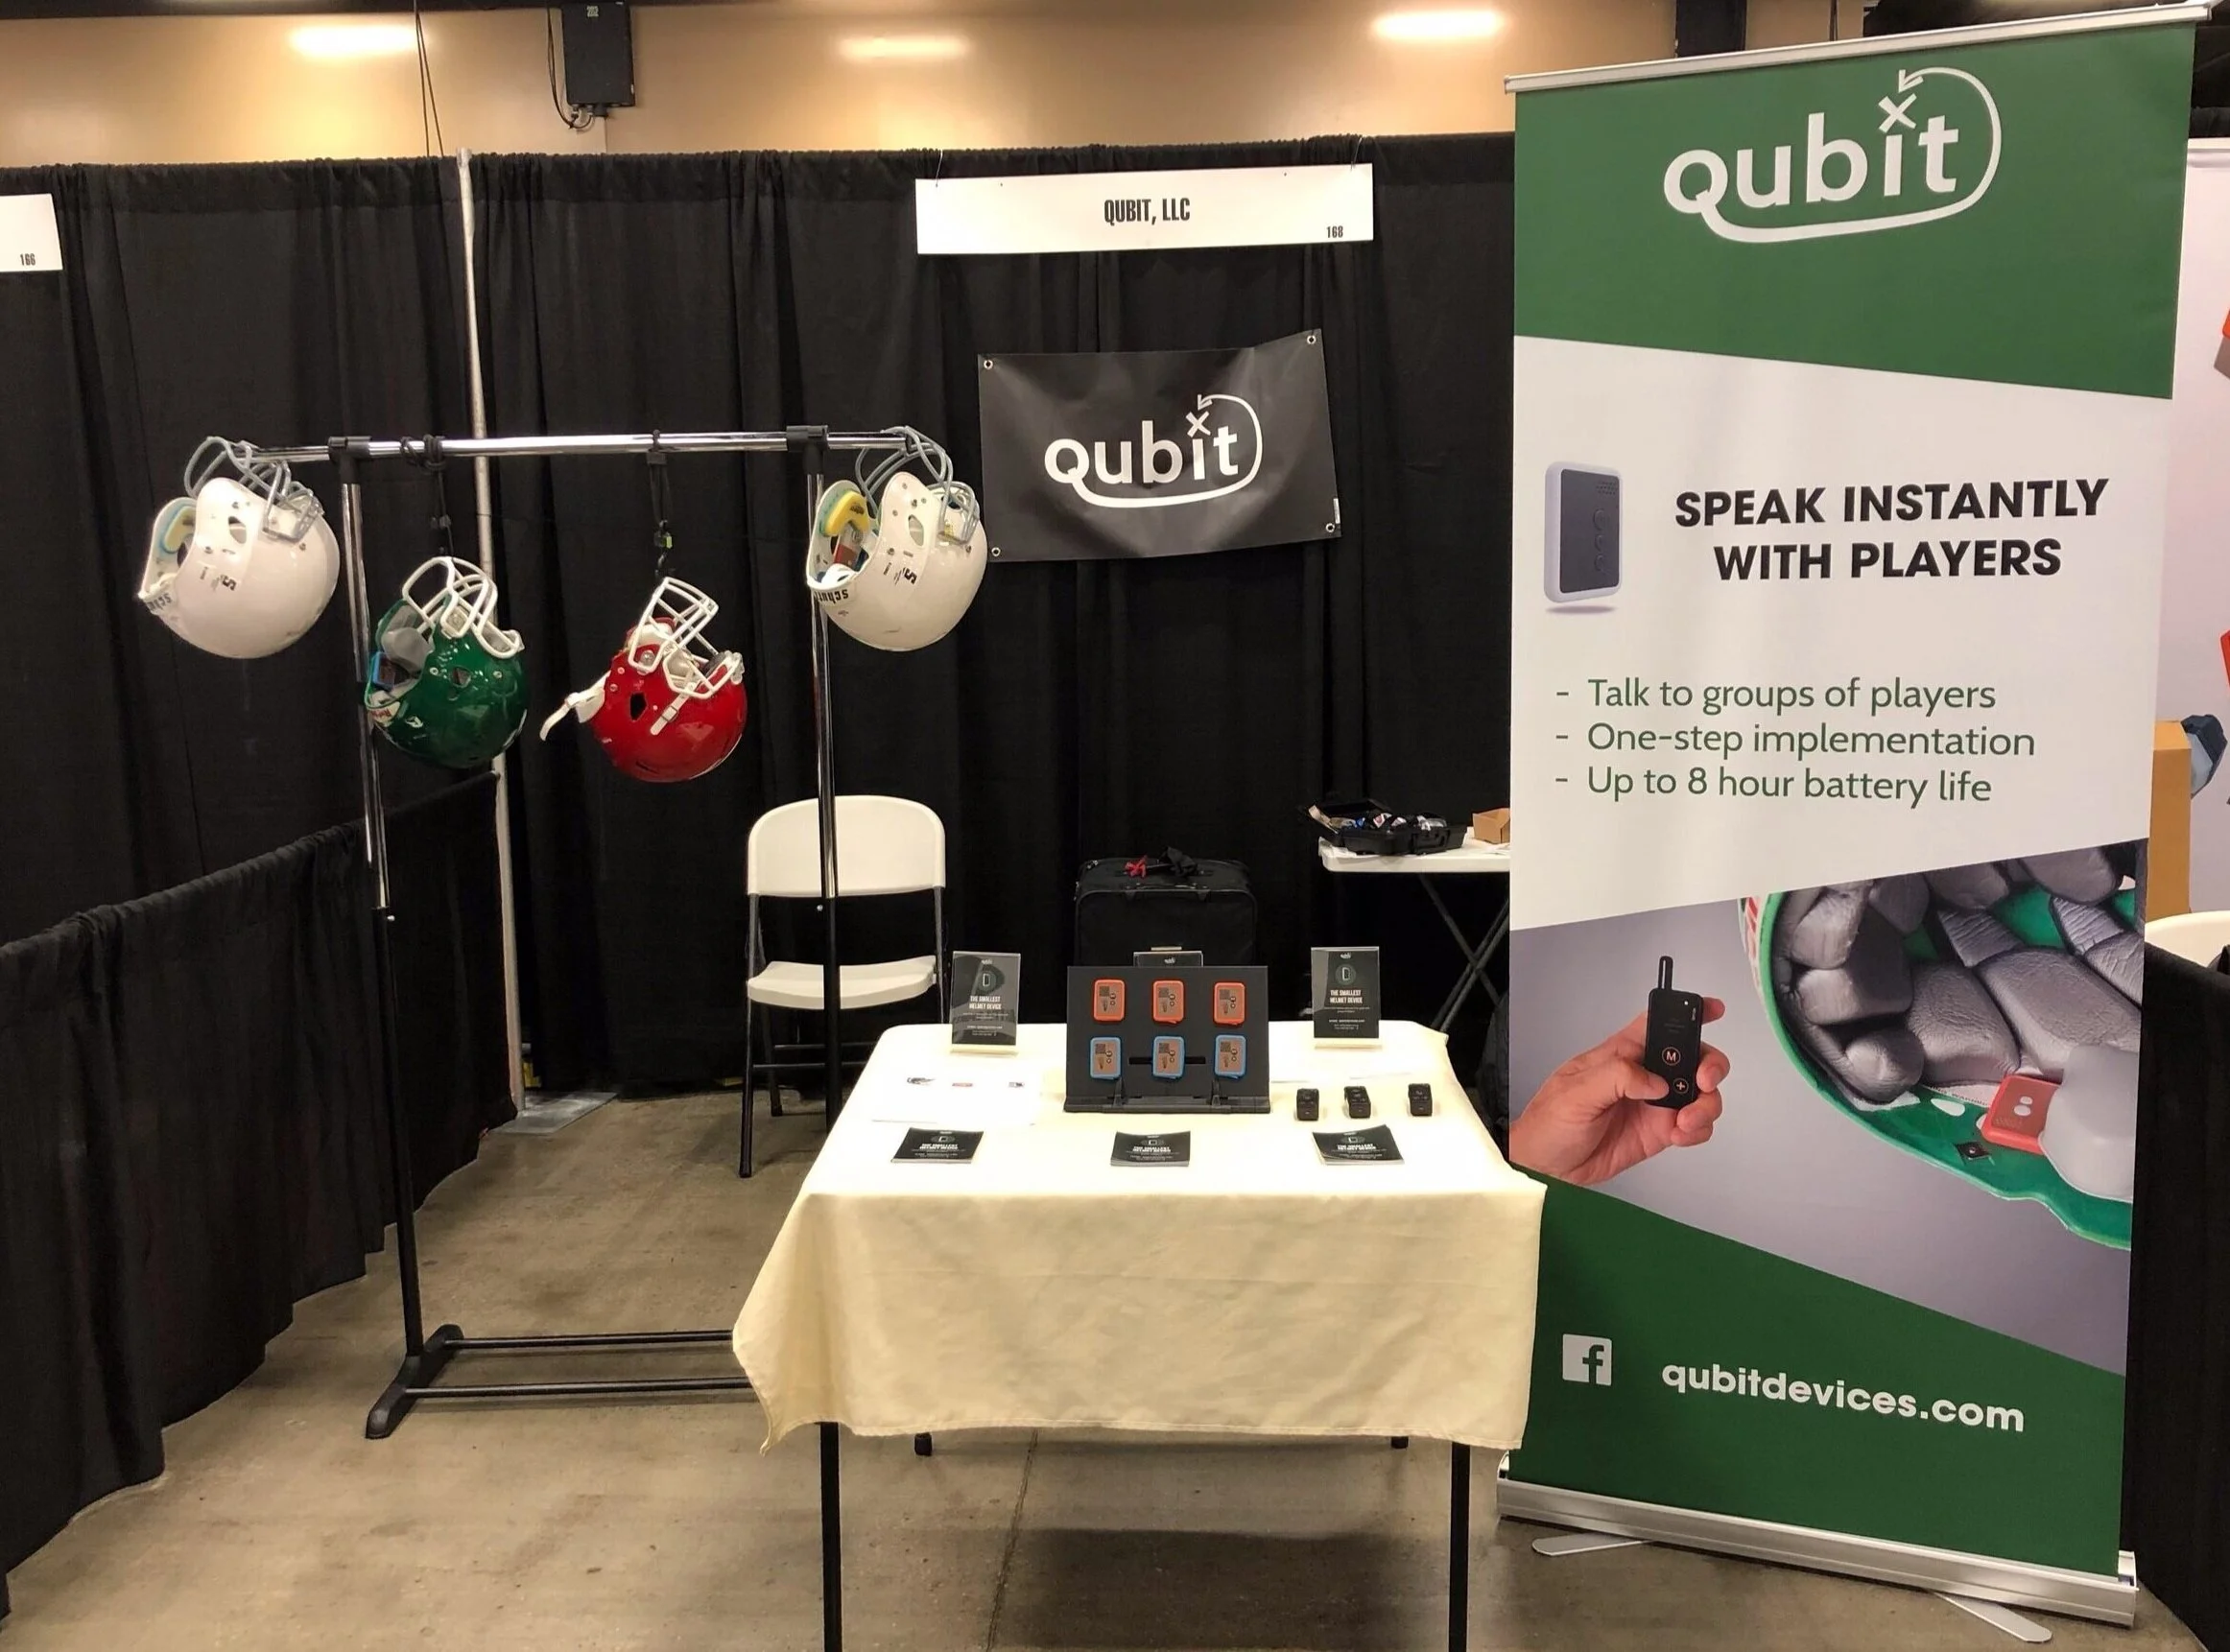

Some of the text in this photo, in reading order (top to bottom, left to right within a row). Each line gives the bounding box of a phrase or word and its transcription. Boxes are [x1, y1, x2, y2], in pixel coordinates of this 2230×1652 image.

[1103, 198, 1191, 226] QUBIT, LLC
[1326, 225, 1343, 239] 168
[19, 252, 36, 267] 166
[1675, 478, 2109, 528] SPEAK INSTANTLY
[1714, 538, 2062, 580] WITH PLAYERS
[1588, 677, 1650, 707] Talk
[1659, 681, 1694, 707] to
[1702, 686, 1815, 717] groups
[1824, 676, 1862, 708] of
[1871, 676, 1997, 718] players
[1588, 721, 1744, 761] One-step
[1753, 721, 2035, 762] implementation
[1588, 766, 1634, 803] Up
[1643, 769, 1677, 794] to
[1687, 767, 1708, 795] 8
[1719, 766, 1795, 797] hour
[1804, 767, 1929, 810] battery
[1939, 769, 1992, 802] life
[1662, 1364, 2024, 1432] qubitdevices.com
